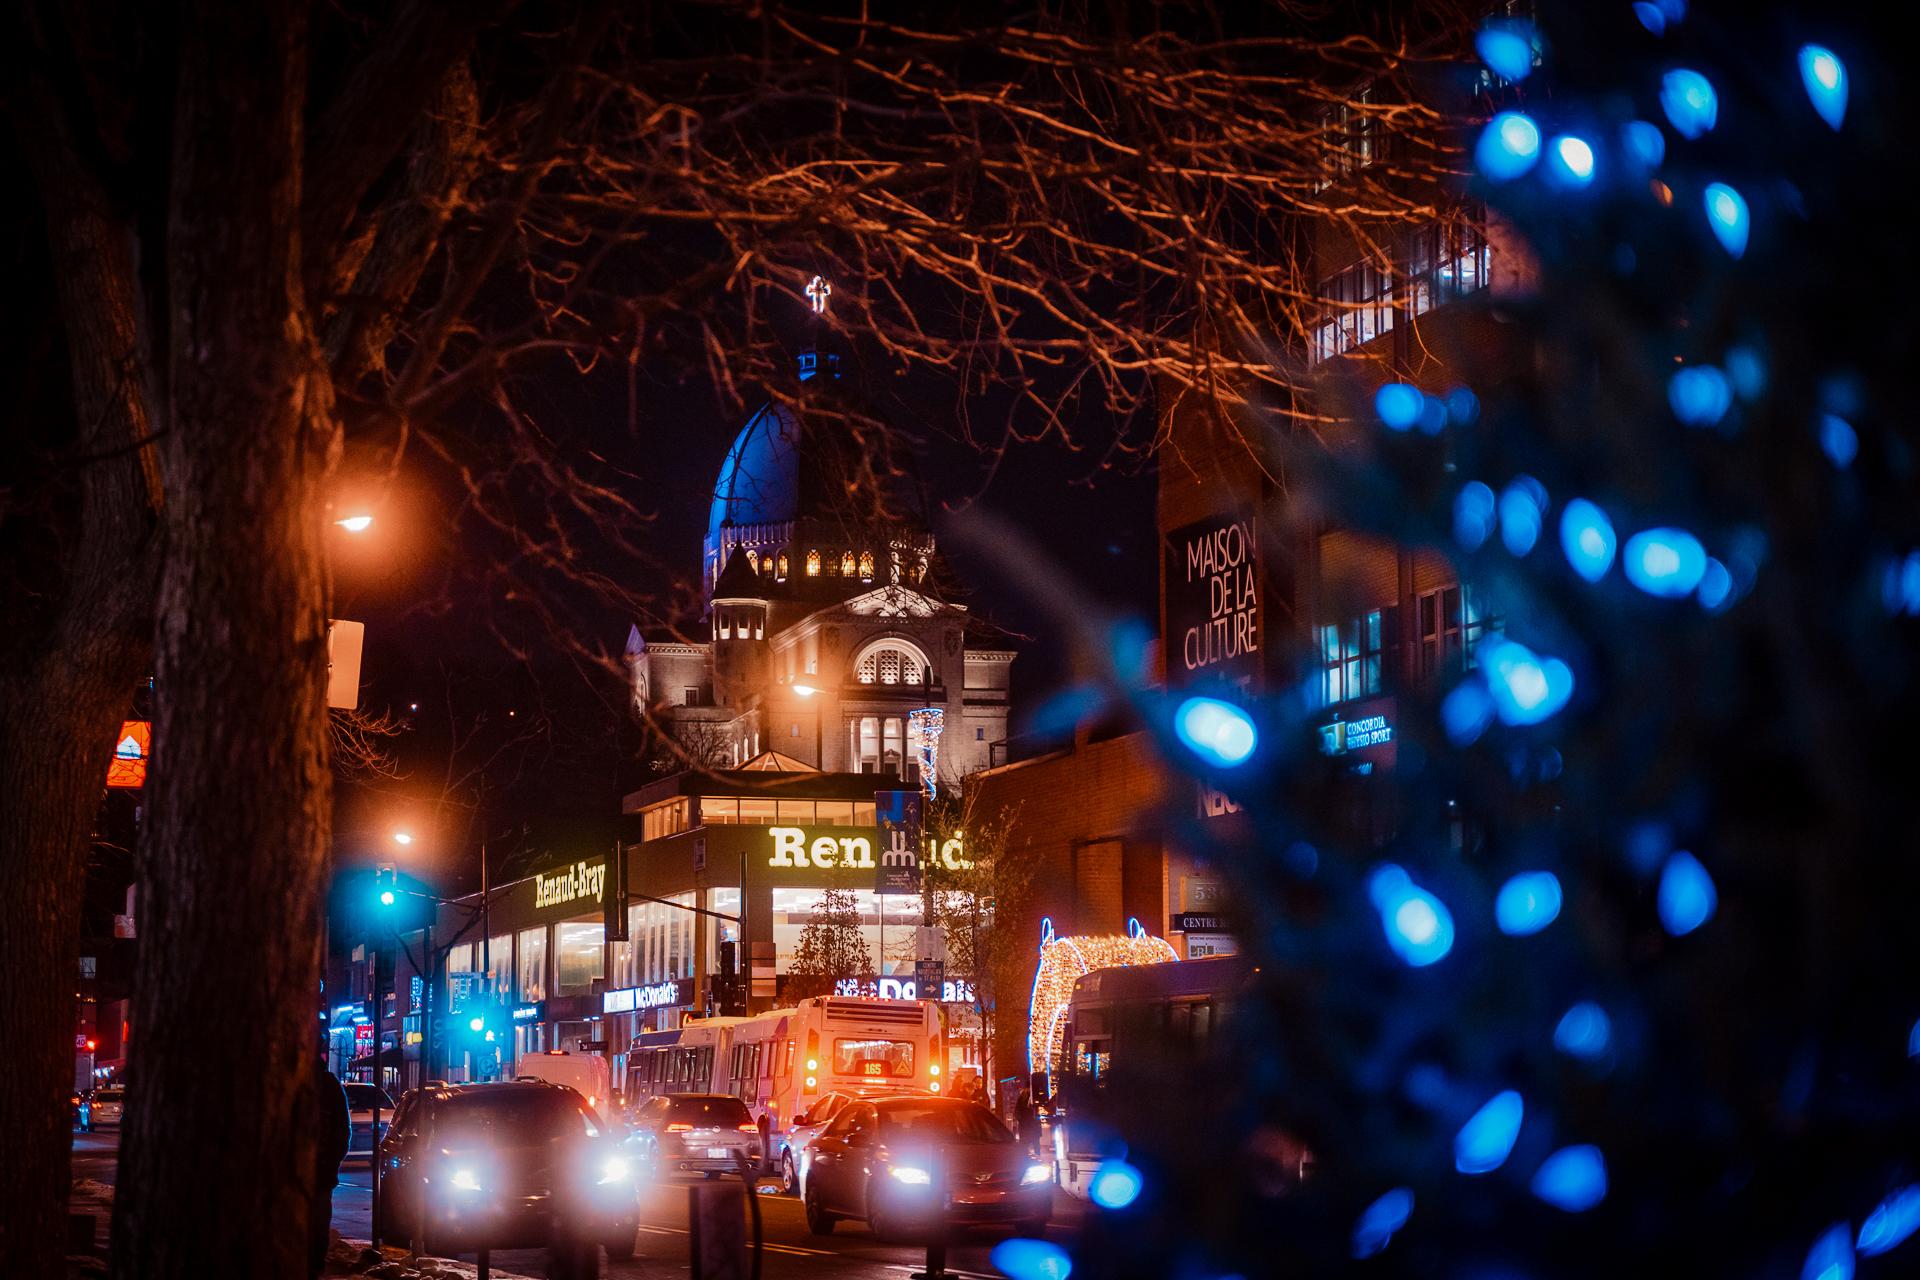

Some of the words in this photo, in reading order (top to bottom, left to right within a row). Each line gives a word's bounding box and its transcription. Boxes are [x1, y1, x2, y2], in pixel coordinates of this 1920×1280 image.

[1187, 515, 1257, 583] MAISON
[1211, 570, 1233, 619] DE
[1236, 563, 1257, 611] LA
[1184, 607, 1258, 670] CULTURE
[1347, 715, 1386, 736] CONCORDIA
[1370, 727, 1391, 745] SPORT
[535, 861, 606, 909] Renaud-Bray
[1183, 917, 1218, 928] CENTRE
[635, 981, 679, 1009] McDonald's
[863, 1062, 882, 1075] 165
